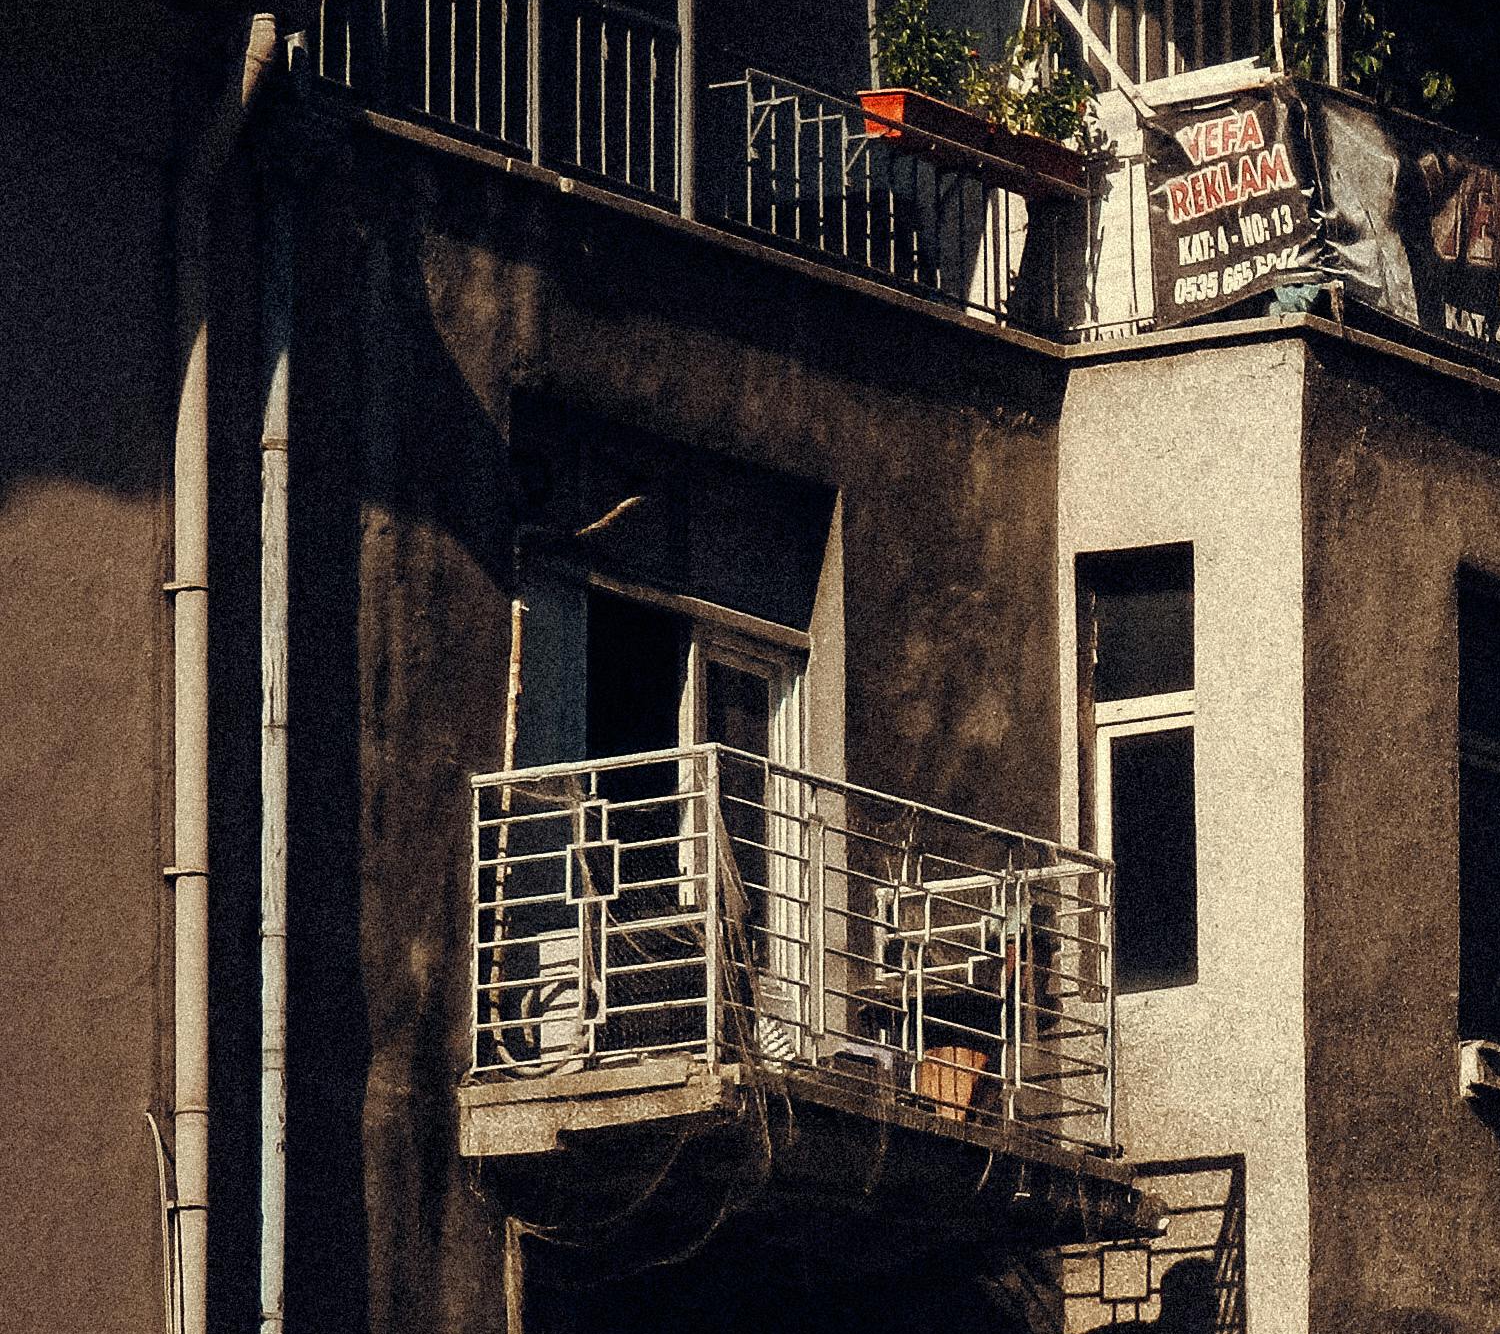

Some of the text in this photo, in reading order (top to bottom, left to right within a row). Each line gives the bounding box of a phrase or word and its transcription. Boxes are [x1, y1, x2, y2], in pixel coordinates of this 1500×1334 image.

[1175, 110, 1265, 165] VEFA
[1167, 143, 1297, 225] REKLAM
[1217, 225, 1229, 255] 4
[1271, 205, 1295, 237] 13
[1174, 270, 1219, 305] 0535
